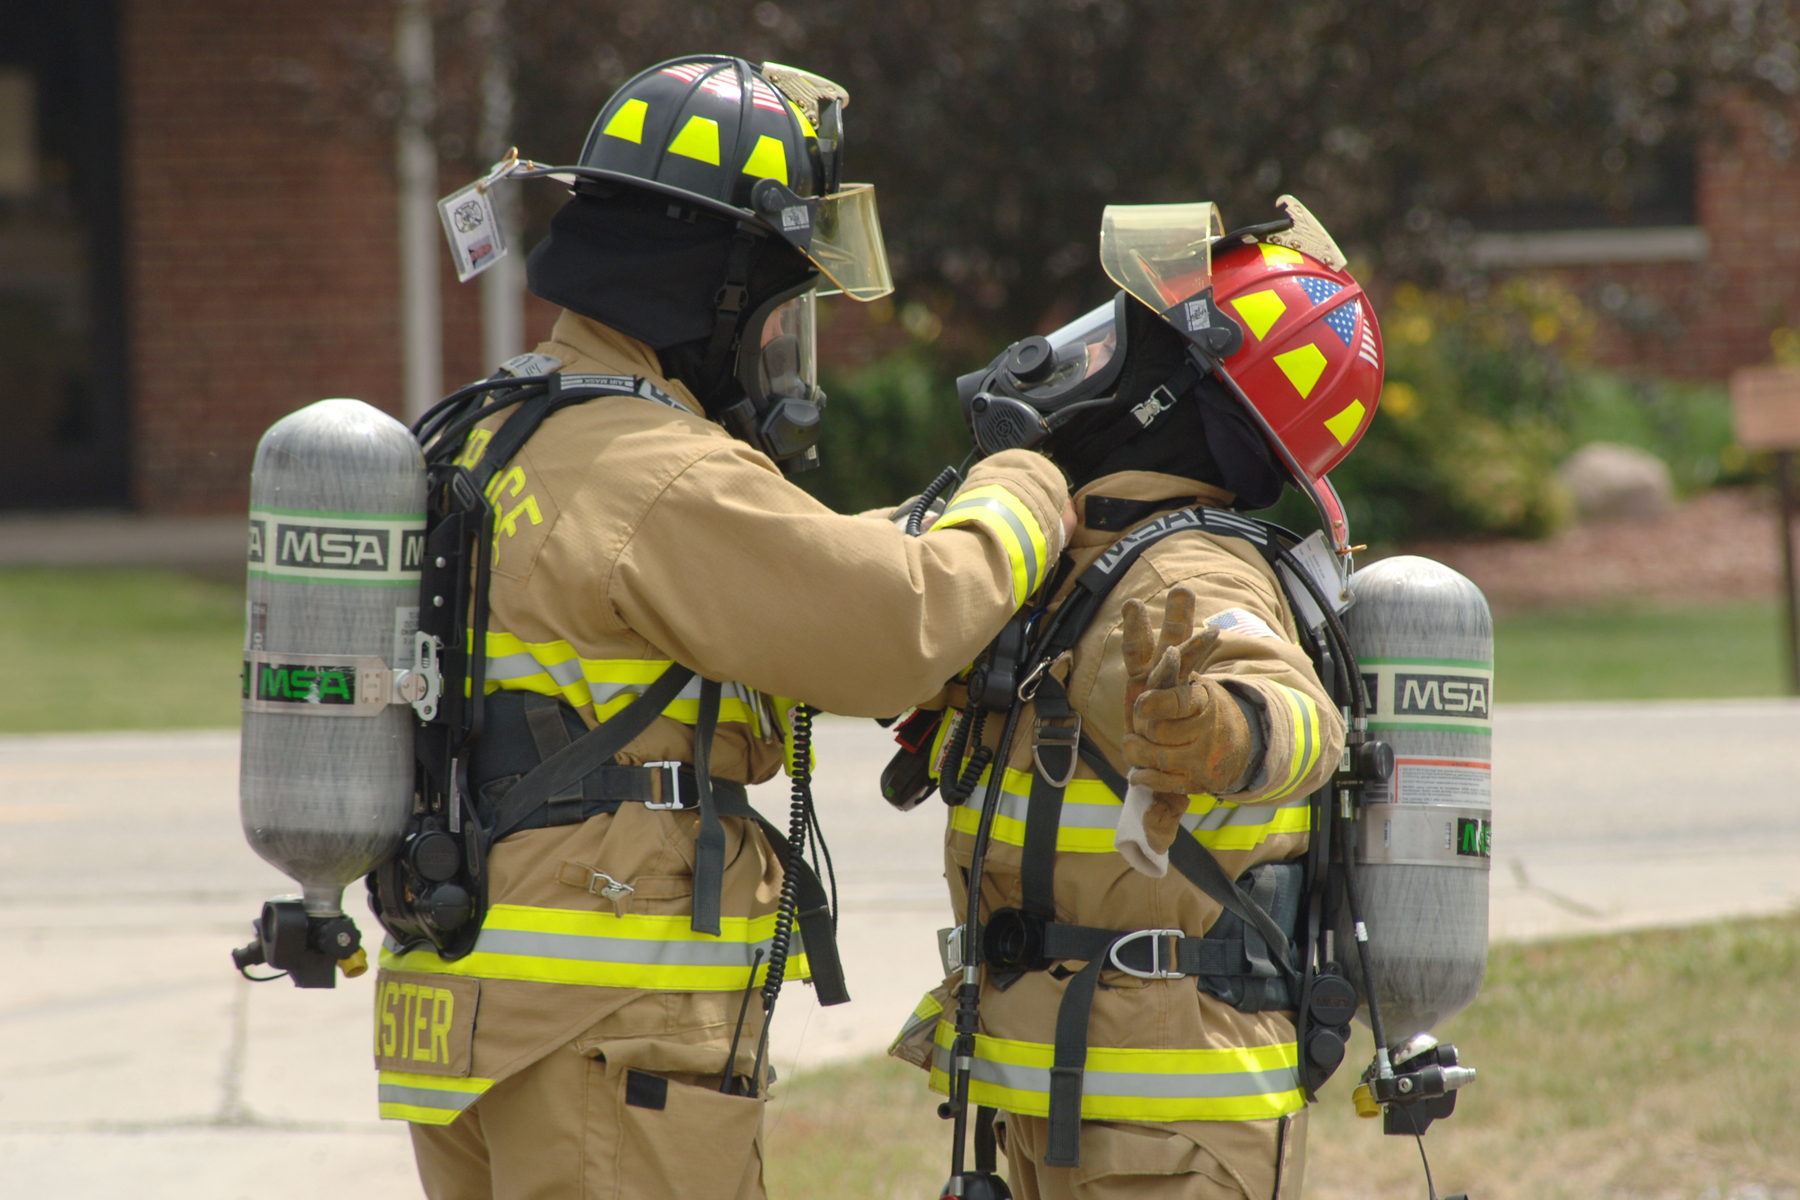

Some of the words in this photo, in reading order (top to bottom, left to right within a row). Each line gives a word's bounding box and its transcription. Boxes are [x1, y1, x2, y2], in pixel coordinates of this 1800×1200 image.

[609, 378, 624, 386] AIR
[281, 530, 384, 566] MSA
[260, 667, 351, 700] MSA
[1402, 679, 1486, 713] MSA
